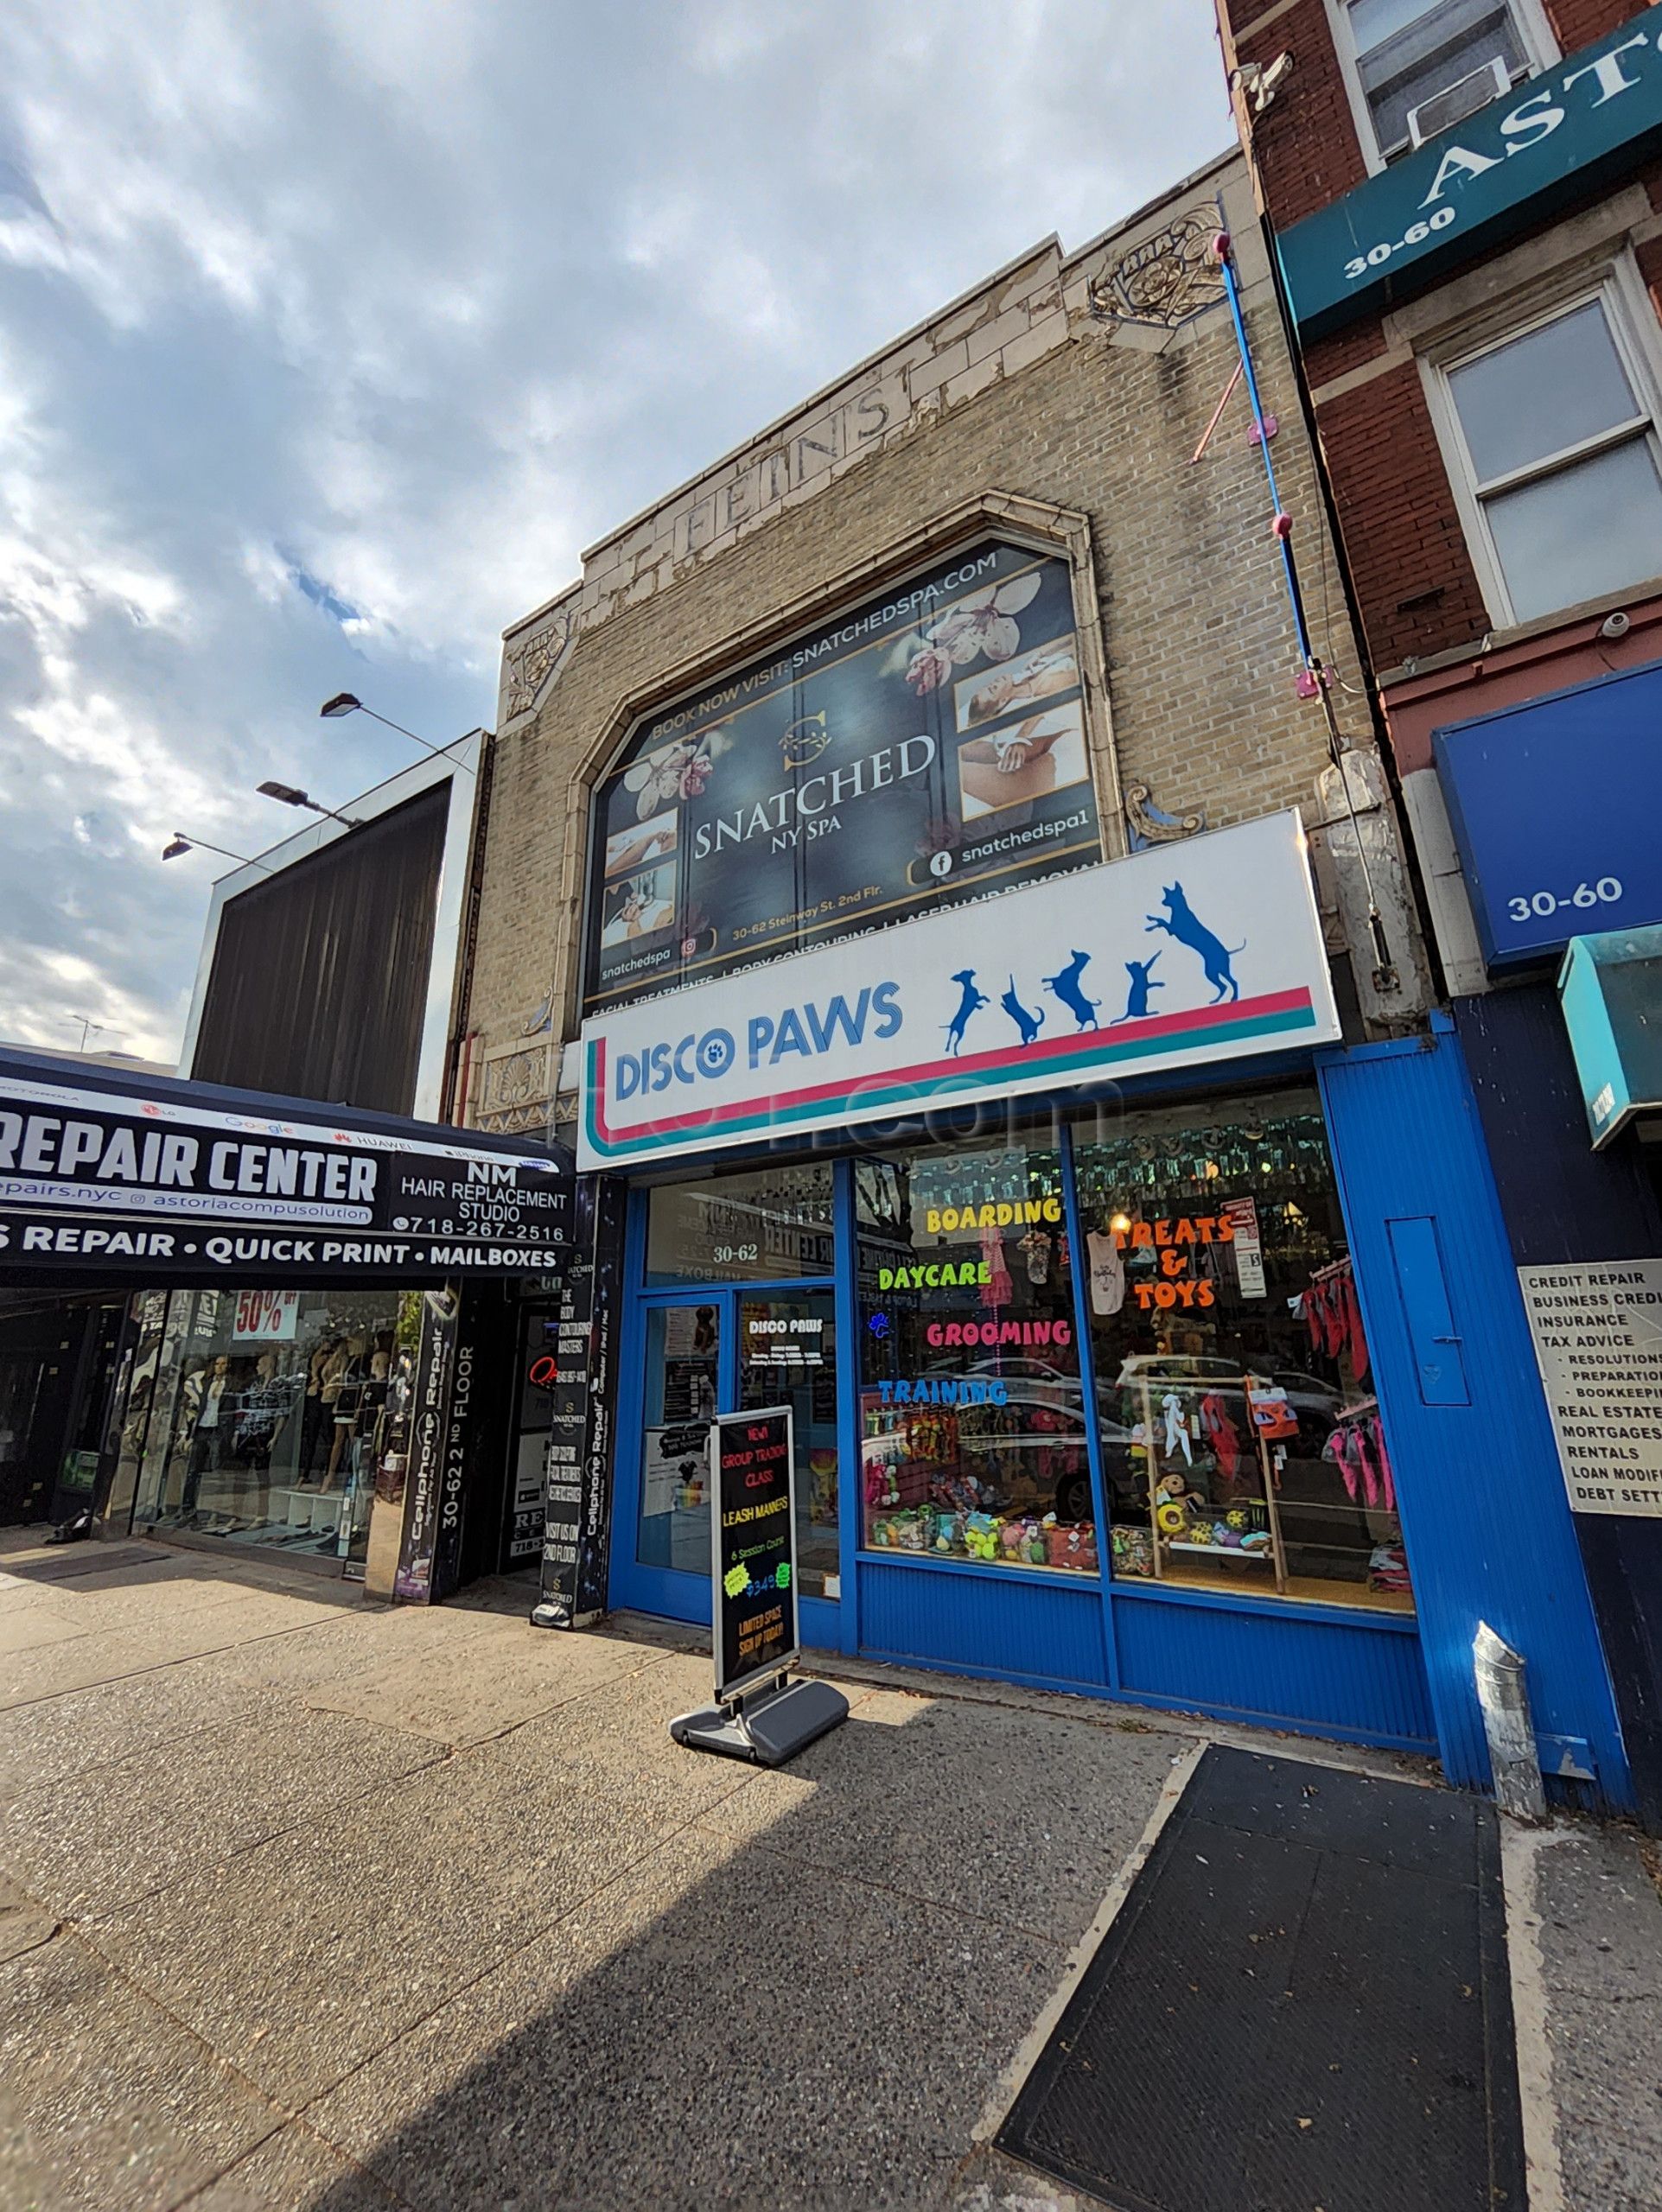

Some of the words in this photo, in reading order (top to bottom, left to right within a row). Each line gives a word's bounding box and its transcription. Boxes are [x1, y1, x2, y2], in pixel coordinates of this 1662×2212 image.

[1417, 31, 1662, 210] AST
[1343, 207, 1455, 279] 30-60
[652, 708, 697, 740] BOOK
[698, 684, 740, 716] NOW
[742, 660, 789, 693] VISIT:
[793, 552, 997, 669] SNATCHEDSPA.COM
[694, 734, 936, 860] SNATCHED
[770, 826, 803, 855] NY
[807, 816, 843, 841] SPA
[962, 809, 1090, 863] snatchedspa1
[1508, 877, 1623, 922] 30-60
[733, 921, 767, 941] 30-62
[768, 906, 818, 930] Steinway
[821, 900, 836, 912] St.
[837, 893, 861, 906] 2nd
[601, 949, 672, 982] snatchedspa
[615, 1027, 735, 1102] DISCO
[748, 981, 903, 1070] PAWS
[225, 1116, 294, 1135] Google
[0, 1110, 200, 1187] REPAIR
[208, 1141, 378, 1202] CENTER
[356, 1136, 412, 1151] HUAWEI
[467, 1161, 517, 1187] NM
[401, 1177, 446, 1198] HAIR
[451, 1182, 567, 1210] REPLACEMENT
[154, 1195, 369, 1221] astoriacompusolution
[458, 1202, 520, 1223] STUDIO
[927, 1198, 1061, 1233] BOARDING
[411, 1217, 564, 1242] 718-267-2516
[1111, 1214, 1236, 1250] TREATS
[22, 1225, 175, 1257] REPAIR
[206, 1236, 315, 1264] QUICK
[322, 1242, 411, 1264] PRINT
[430, 1247, 557, 1268] MAILBOXES
[713, 1243, 758, 1263] 30-62
[879, 1260, 992, 1290] DAYCARE
[1161, 1249, 1188, 1276] &
[1529, 1274, 1582, 1288] CREDIT
[1588, 1272, 1646, 1286] REPAIR
[1134, 1278, 1215, 1310] TOYS
[1533, 1294, 1609, 1308] BUSINESS
[237, 1290, 282, 1332] 50%
[1538, 1313, 1628, 1328] INSURANCE
[749, 1319, 787, 1334] DISCO
[790, 1318, 823, 1333] PAWS
[927, 1319, 1072, 1346] GROOMING
[1542, 1336, 1572, 1348] TAX
[1576, 1334, 1635, 1347] ADVICE
[1569, 1353, 1662, 1365] RESOLUTIONS
[455, 1346, 474, 1418] FLOOR
[878, 1379, 1009, 1407] TRAINING
[1557, 1405, 1598, 1418] REAL
[1603, 1406, 1662, 1419] ESTATE
[411, 1413, 435, 1541] Cellphone
[426, 1328, 443, 1406] Repair
[450, 1424, 461, 1443] ND
[593, 1405, 603, 1452] Repair
[1562, 1426, 1662, 1440] MORTGAGES
[449, 1447, 464, 1460] 2
[722, 1451, 754, 1469] GROUP
[1567, 1446, 1640, 1460] RENTALS
[745, 1470, 774, 1488] CLASS
[1571, 1466, 1609, 1479] LOAN
[443, 1465, 462, 1529] 30-62
[588, 1455, 601, 1535] Cellphone
[1576, 1487, 1615, 1500] DEBT
[723, 1507, 755, 1527] LEASH
[731, 1550, 737, 1560] 6
[739, 1543, 766, 1559] Session
